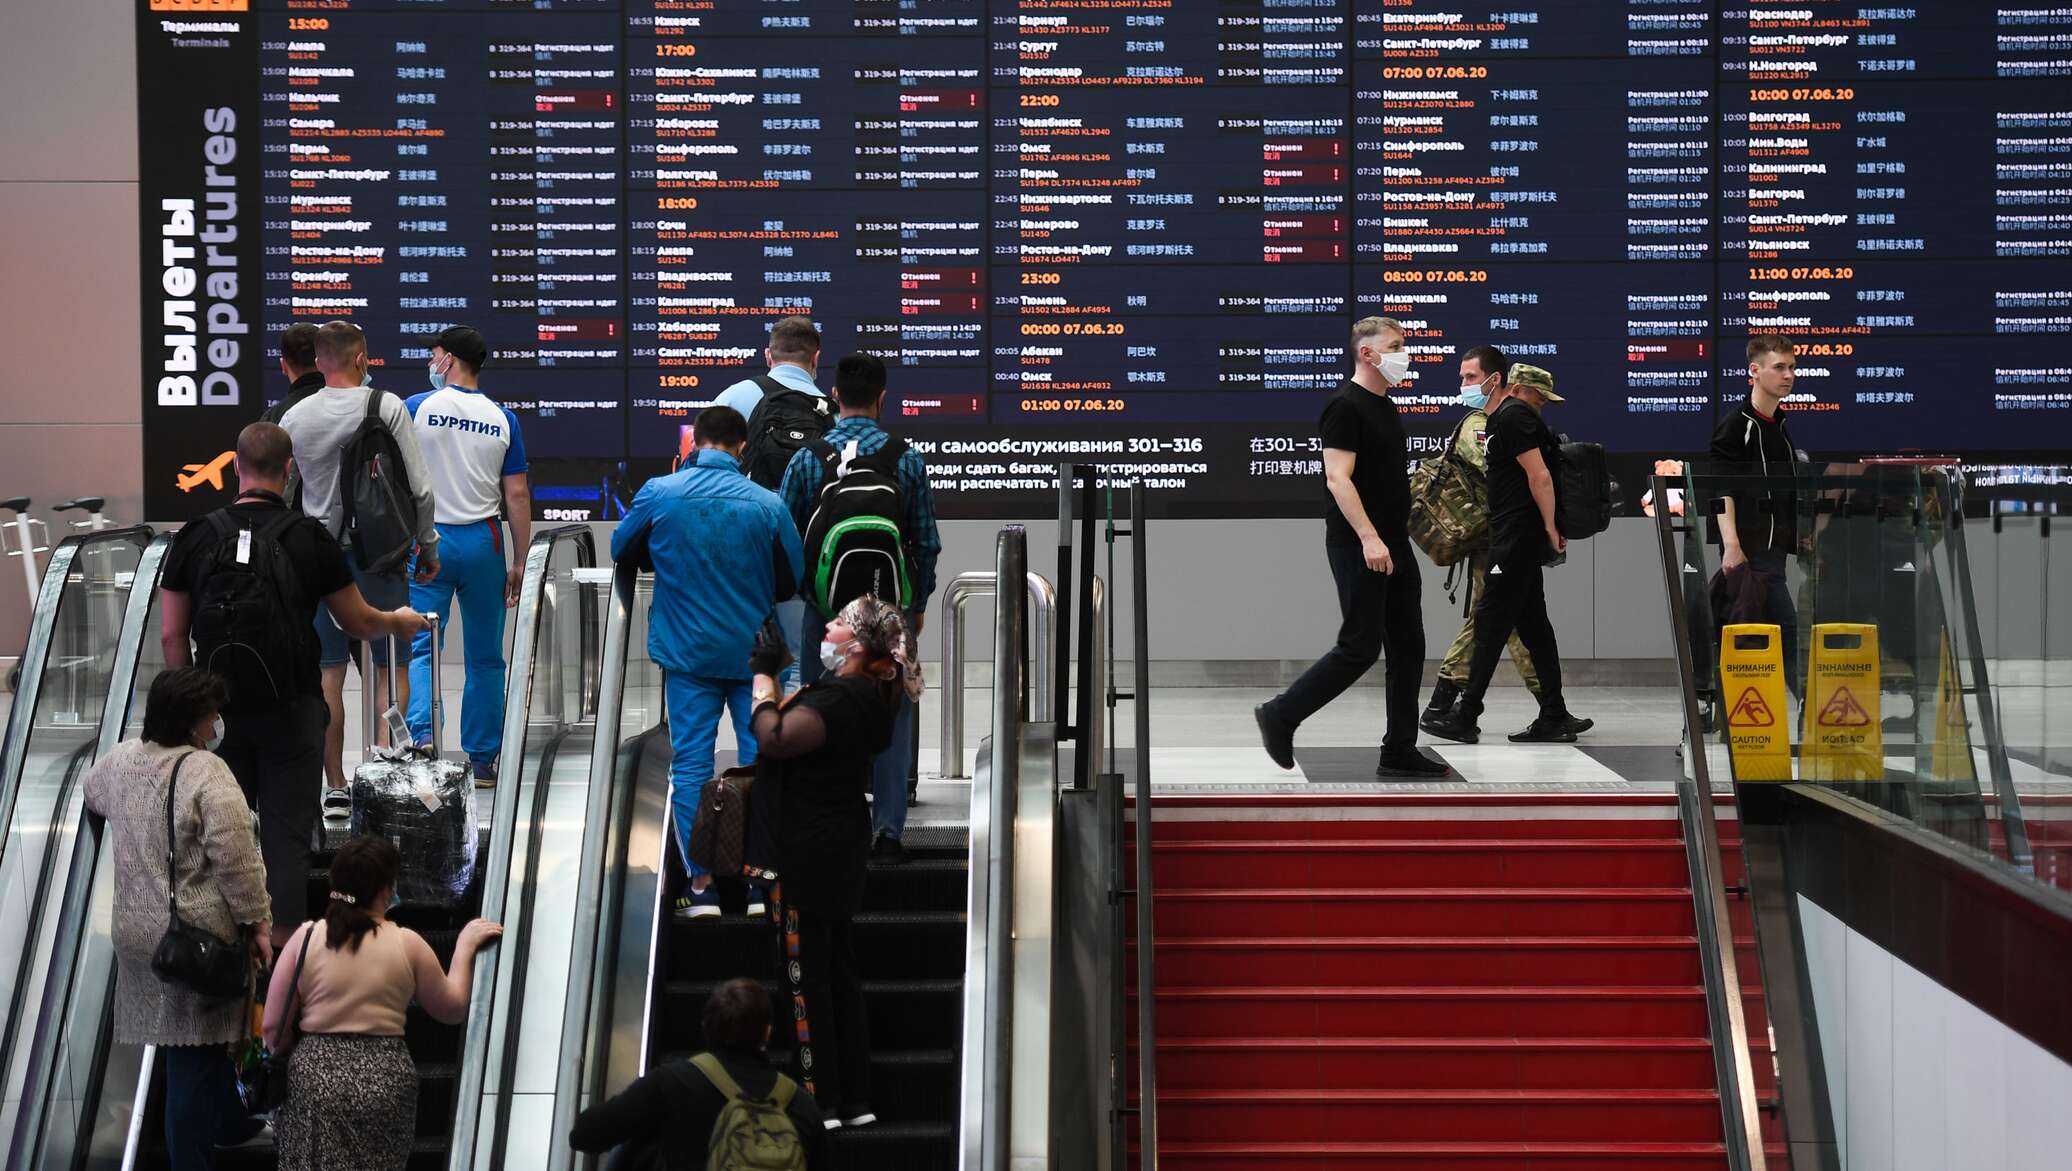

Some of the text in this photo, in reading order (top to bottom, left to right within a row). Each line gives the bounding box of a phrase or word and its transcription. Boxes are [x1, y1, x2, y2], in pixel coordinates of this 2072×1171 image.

[655, 16, 700, 26] Ижевск
[1019, 15, 1067, 27] Барнаул
[1383, 12, 1464, 25] Екатеринбург
[1749, 9, 1813, 22] Краснодар
[160, 21, 240, 34] Терминалы
[289, 18, 329, 30] 15:00
[171, 38, 230, 47] Terminals
[287, 41, 325, 51] Анапа
[1019, 41, 1058, 53] Сургут
[1383, 38, 1482, 51] Санкт-Петербург
[1749, 34, 1849, 48] Санкт-Петербург
[656, 45, 695, 57] 17:00
[288, 67, 354, 77] Махачкала
[655, 67, 757, 77] Южно-Сахалинск
[1019, 67, 1082, 78] Краснодар
[1749, 61, 1817, 72] Н.Новгород
[1383, 67, 1487, 79] 07:00 07.06.20
[289, 92, 340, 102] Нальчик
[655, 92, 755, 105] Санкт-Петербург
[1021, 95, 1059, 106] 22:00
[1383, 90, 1458, 100] Нижнекамск
[1750, 89, 1854, 101] 10:00 07.06.20
[1019, 117, 1082, 127] Челябинск
[1383, 116, 1443, 128] Мурманск
[1749, 112, 1810, 124] Волгоград
[289, 118, 335, 131] Самара
[655, 118, 719, 131] Хабаровск
[1020, 143, 1051, 153] Омск
[1383, 140, 1464, 152] Симферополь
[1749, 137, 1808, 148] Мин.Воды
[290, 143, 330, 155] Пермь
[656, 144, 738, 156] Симферополь
[290, 169, 391, 181] Санкт-Петербург
[656, 169, 718, 181] Волгоград
[1020, 168, 1059, 181] Пермь
[1383, 166, 1422, 178] Пермь
[1749, 163, 1826, 175] Калининград
[1020, 194, 1112, 205] Нижневартовск
[1383, 191, 1475, 204] Ростов-на-Дону
[1749, 189, 1805, 200] Белгород
[290, 195, 352, 207] Мурманск
[658, 198, 697, 209] 18:00
[657, 220, 686, 230] Сочи
[1020, 219, 1079, 231] Кемерово
[1383, 217, 1429, 227] Бишкек
[1748, 213, 1848, 226] Санкт-Петербург
[291, 220, 372, 232] Екатеринбург
[656, 246, 694, 256] Анапа
[1020, 244, 1112, 256] Ростов-на-Дону
[1383, 243, 1458, 254] Владикавказ
[1748, 240, 1810, 250] Ульяновск
[199, 107, 248, 405] Departures
[291, 246, 384, 258] Ростов-на-Дону
[291, 271, 349, 283] Оренбург
[657, 271, 732, 282] Владивосток
[1022, 273, 1060, 284] 23:00
[1384, 271, 1487, 282] 08:00 07.06.20
[1749, 268, 1853, 280] 11:00 07.06.20
[158, 199, 197, 406] Вылеты
[658, 297, 735, 308] Калининград
[1020, 295, 1067, 305] Тюмень
[1264, 297, 1314, 307] Регистрация
[1383, 294, 1447, 303] Махачкала
[1748, 290, 1830, 303] Симферополь
[292, 297, 368, 309] Владивосток
[1748, 316, 1811, 326] Челябинск
[657, 321, 721, 334] Хабаровск
[1021, 323, 1124, 335] 00:00 07.06.20
[658, 347, 757, 359] Санкт-Петербург
[1020, 346, 1063, 356] Абакан
[1793, 344, 1853, 356] 07.06.20
[660, 376, 698, 387] 19:00
[1021, 372, 1052, 381] Омск
[1021, 399, 1124, 411] 01:00 07.06.20
[427, 414, 501, 437] БУРЯТИЯ
[941, 438, 1123, 456] самообслуживания
[925, 464, 962, 476] реди
[965, 464, 1006, 475] сдать
[1009, 462, 1057, 475] багаж,
[1250, 460, 1322, 475] 打印登机牌
[930, 480, 957, 489] или
[960, 479, 1048, 492] распечатать
[1143, 478, 1185, 488] талон
[543, 509, 591, 522] SPORT
[1727, 664, 1777, 672] ВНИМАНИЕ
[1731, 735, 1771, 744] CAUTION
